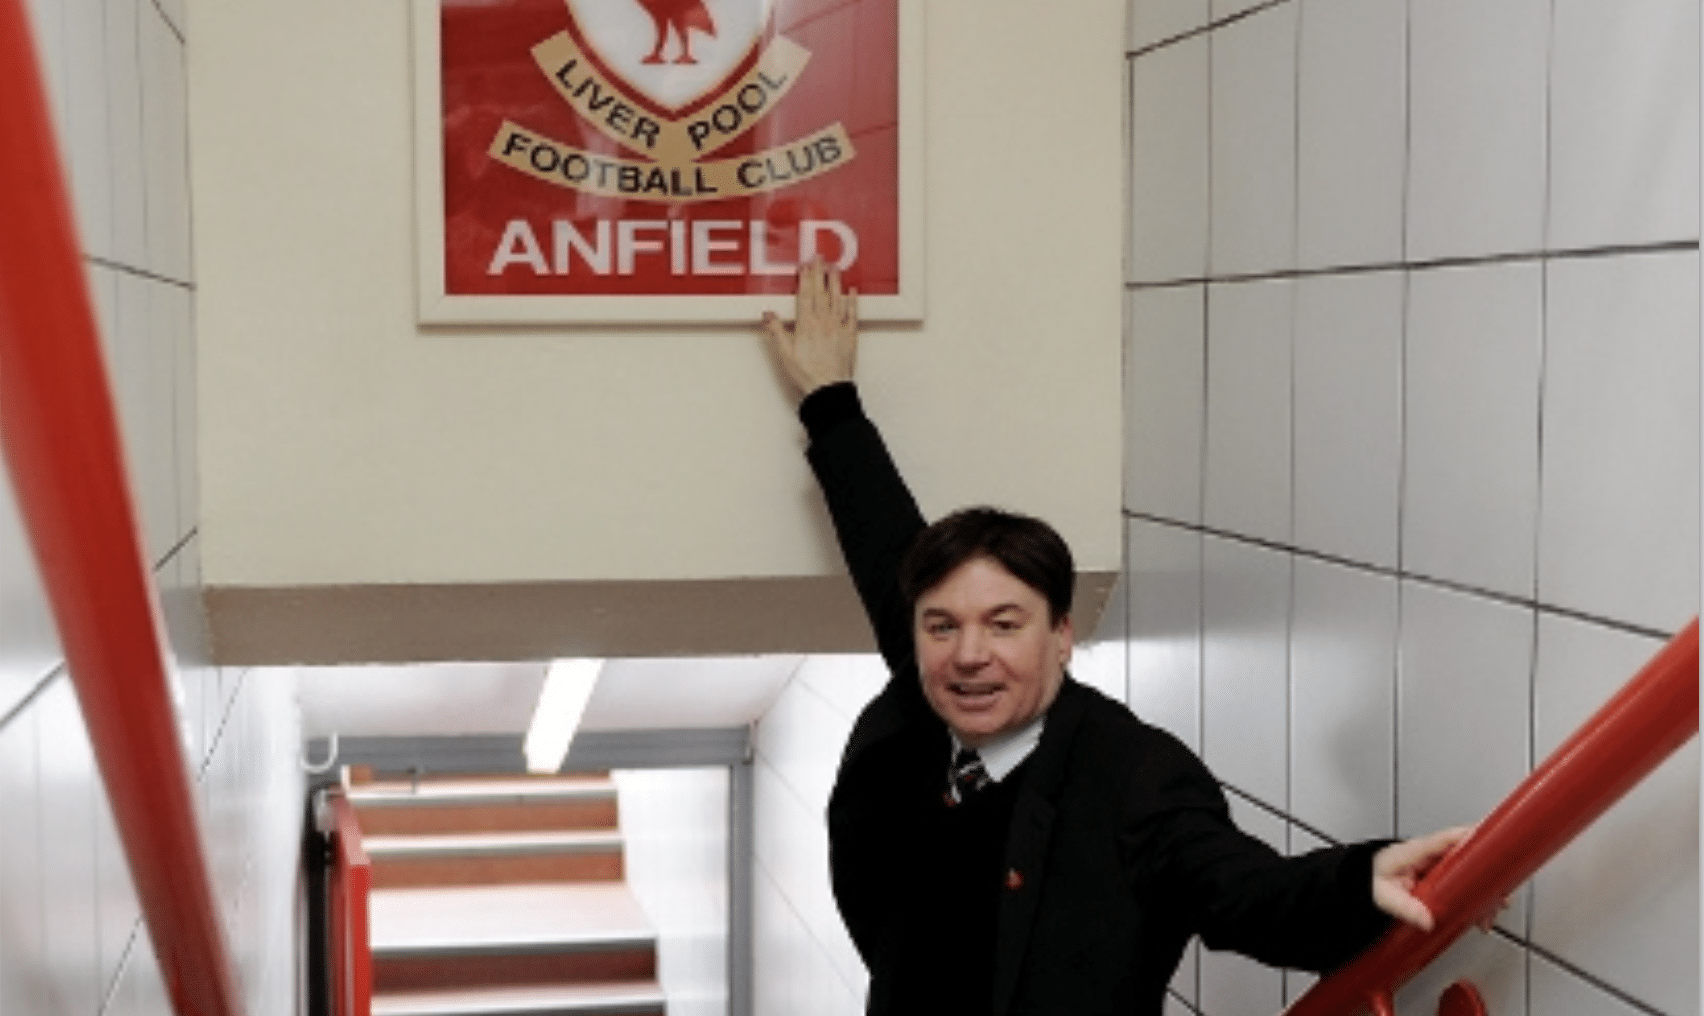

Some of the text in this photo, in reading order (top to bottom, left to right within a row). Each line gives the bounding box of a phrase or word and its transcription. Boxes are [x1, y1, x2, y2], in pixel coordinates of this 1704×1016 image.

[556, 59, 788, 151] LIVER POOL
[502, 131, 842, 197] FOOTBALL CLUB
[487, 218, 859, 277] ANFIELD
